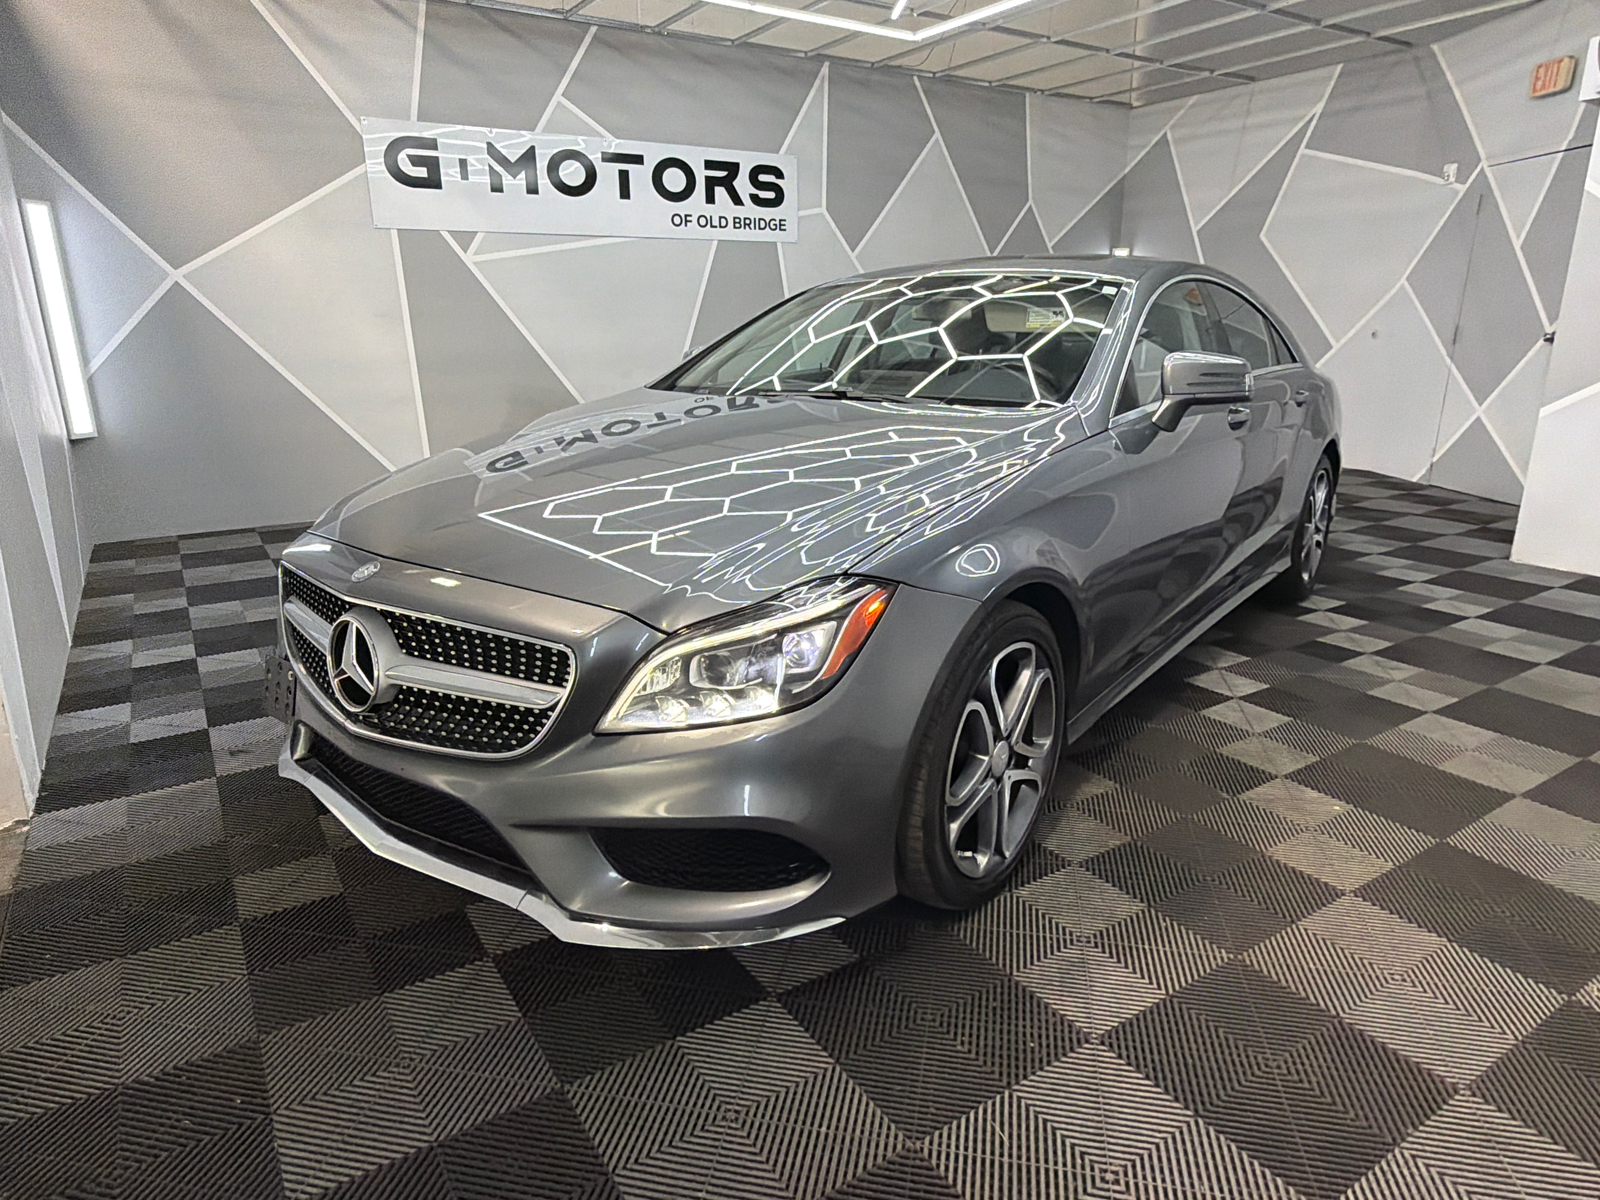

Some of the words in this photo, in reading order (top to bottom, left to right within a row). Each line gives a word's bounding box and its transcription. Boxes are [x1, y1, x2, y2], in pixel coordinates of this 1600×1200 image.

[1532, 58, 1564, 94] EXIT
[486, 141, 785, 208] MOTORS
[671, 214, 692, 227] OF
[697, 215, 729, 229] OLD
[733, 217, 787, 231] BRIDGE
